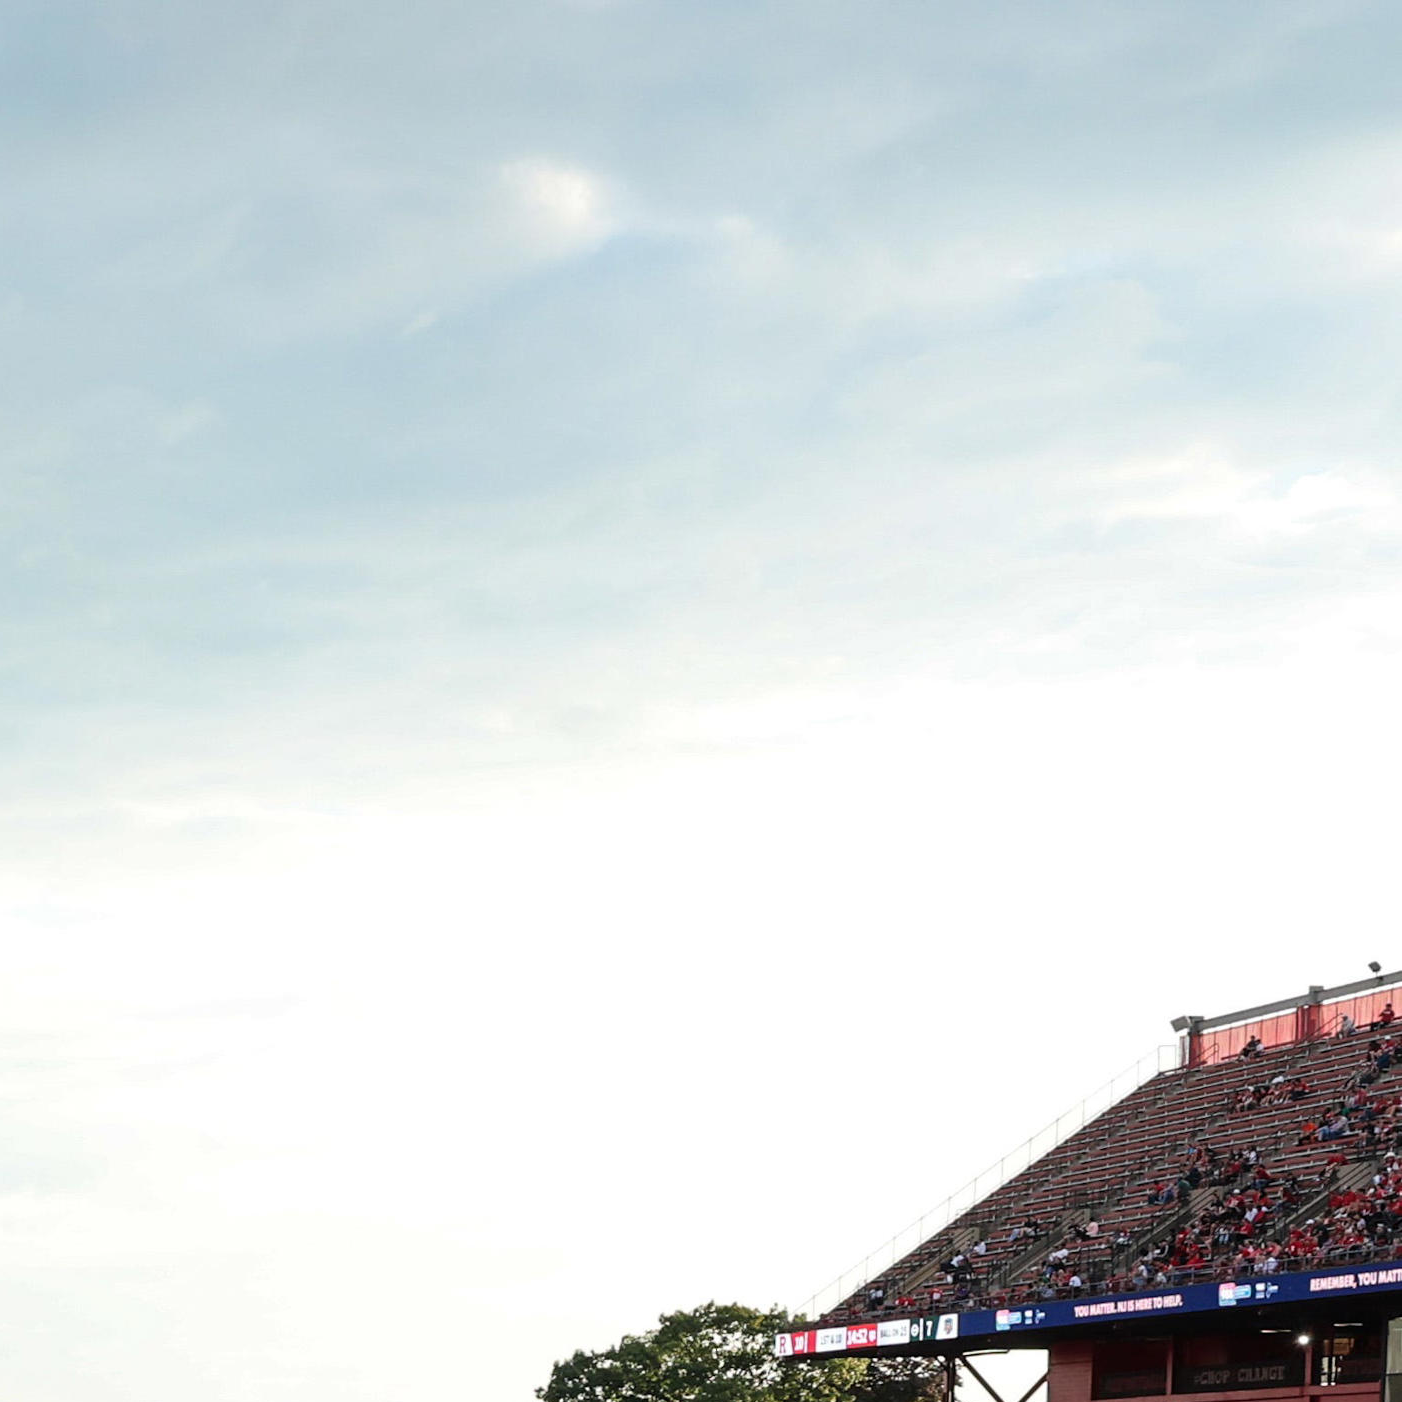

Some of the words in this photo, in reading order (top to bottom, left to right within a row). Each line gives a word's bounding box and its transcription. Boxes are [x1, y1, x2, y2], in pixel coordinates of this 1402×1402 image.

[1358, 1272, 1378, 1286] YOU
[1074, 1304, 1089, 1317] YOU
[1090, 1302, 1117, 1316] MATTER.
[1135, 1298, 1152, 1311] HERE
[1153, 1296, 1163, 1309] TO
